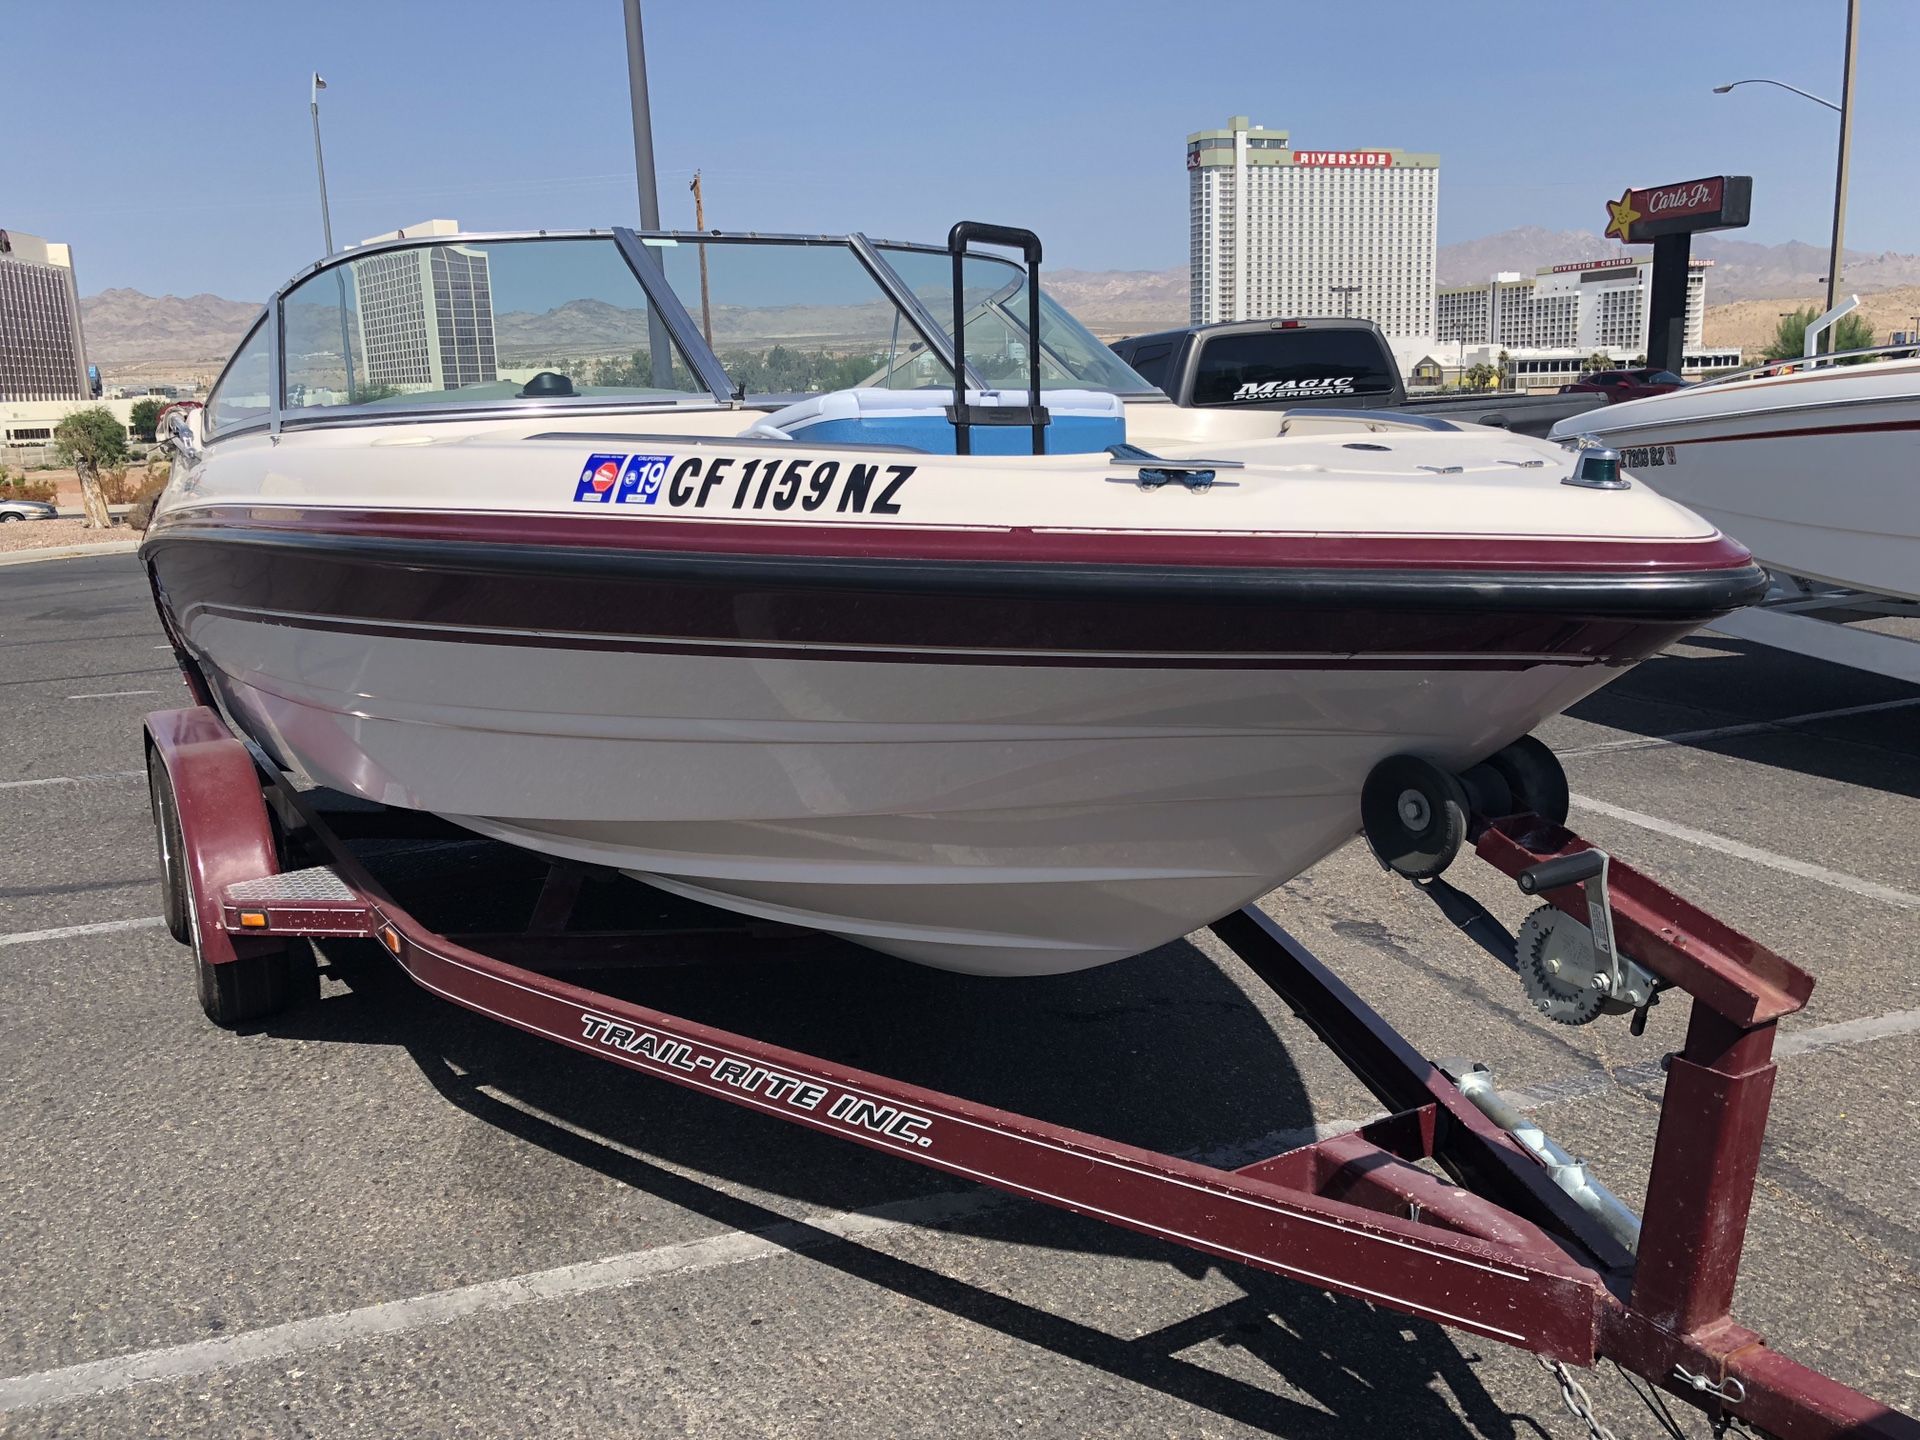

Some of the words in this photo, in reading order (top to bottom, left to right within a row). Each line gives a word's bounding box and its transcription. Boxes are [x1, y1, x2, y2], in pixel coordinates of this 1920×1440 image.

[1300, 152, 1386, 165] RIVERSIDE
[1649, 186, 1688, 213] Carl's
[1688, 183, 1712, 207] Jr.
[1554, 262, 1596, 272] RIVERSIDE
[1600, 258, 1631, 267] CASINO
[1233, 377, 1354, 395] MAGIC
[1233, 387, 1354, 400] POWERBOATS
[636, 462, 666, 494] 19
[668, 458, 736, 507] CF
[732, 459, 841, 512] 1159
[836, 463, 917, 514] NZ
[580, 1013, 829, 1111] TRAIL-RITE
[826, 1093, 933, 1148] INC.
